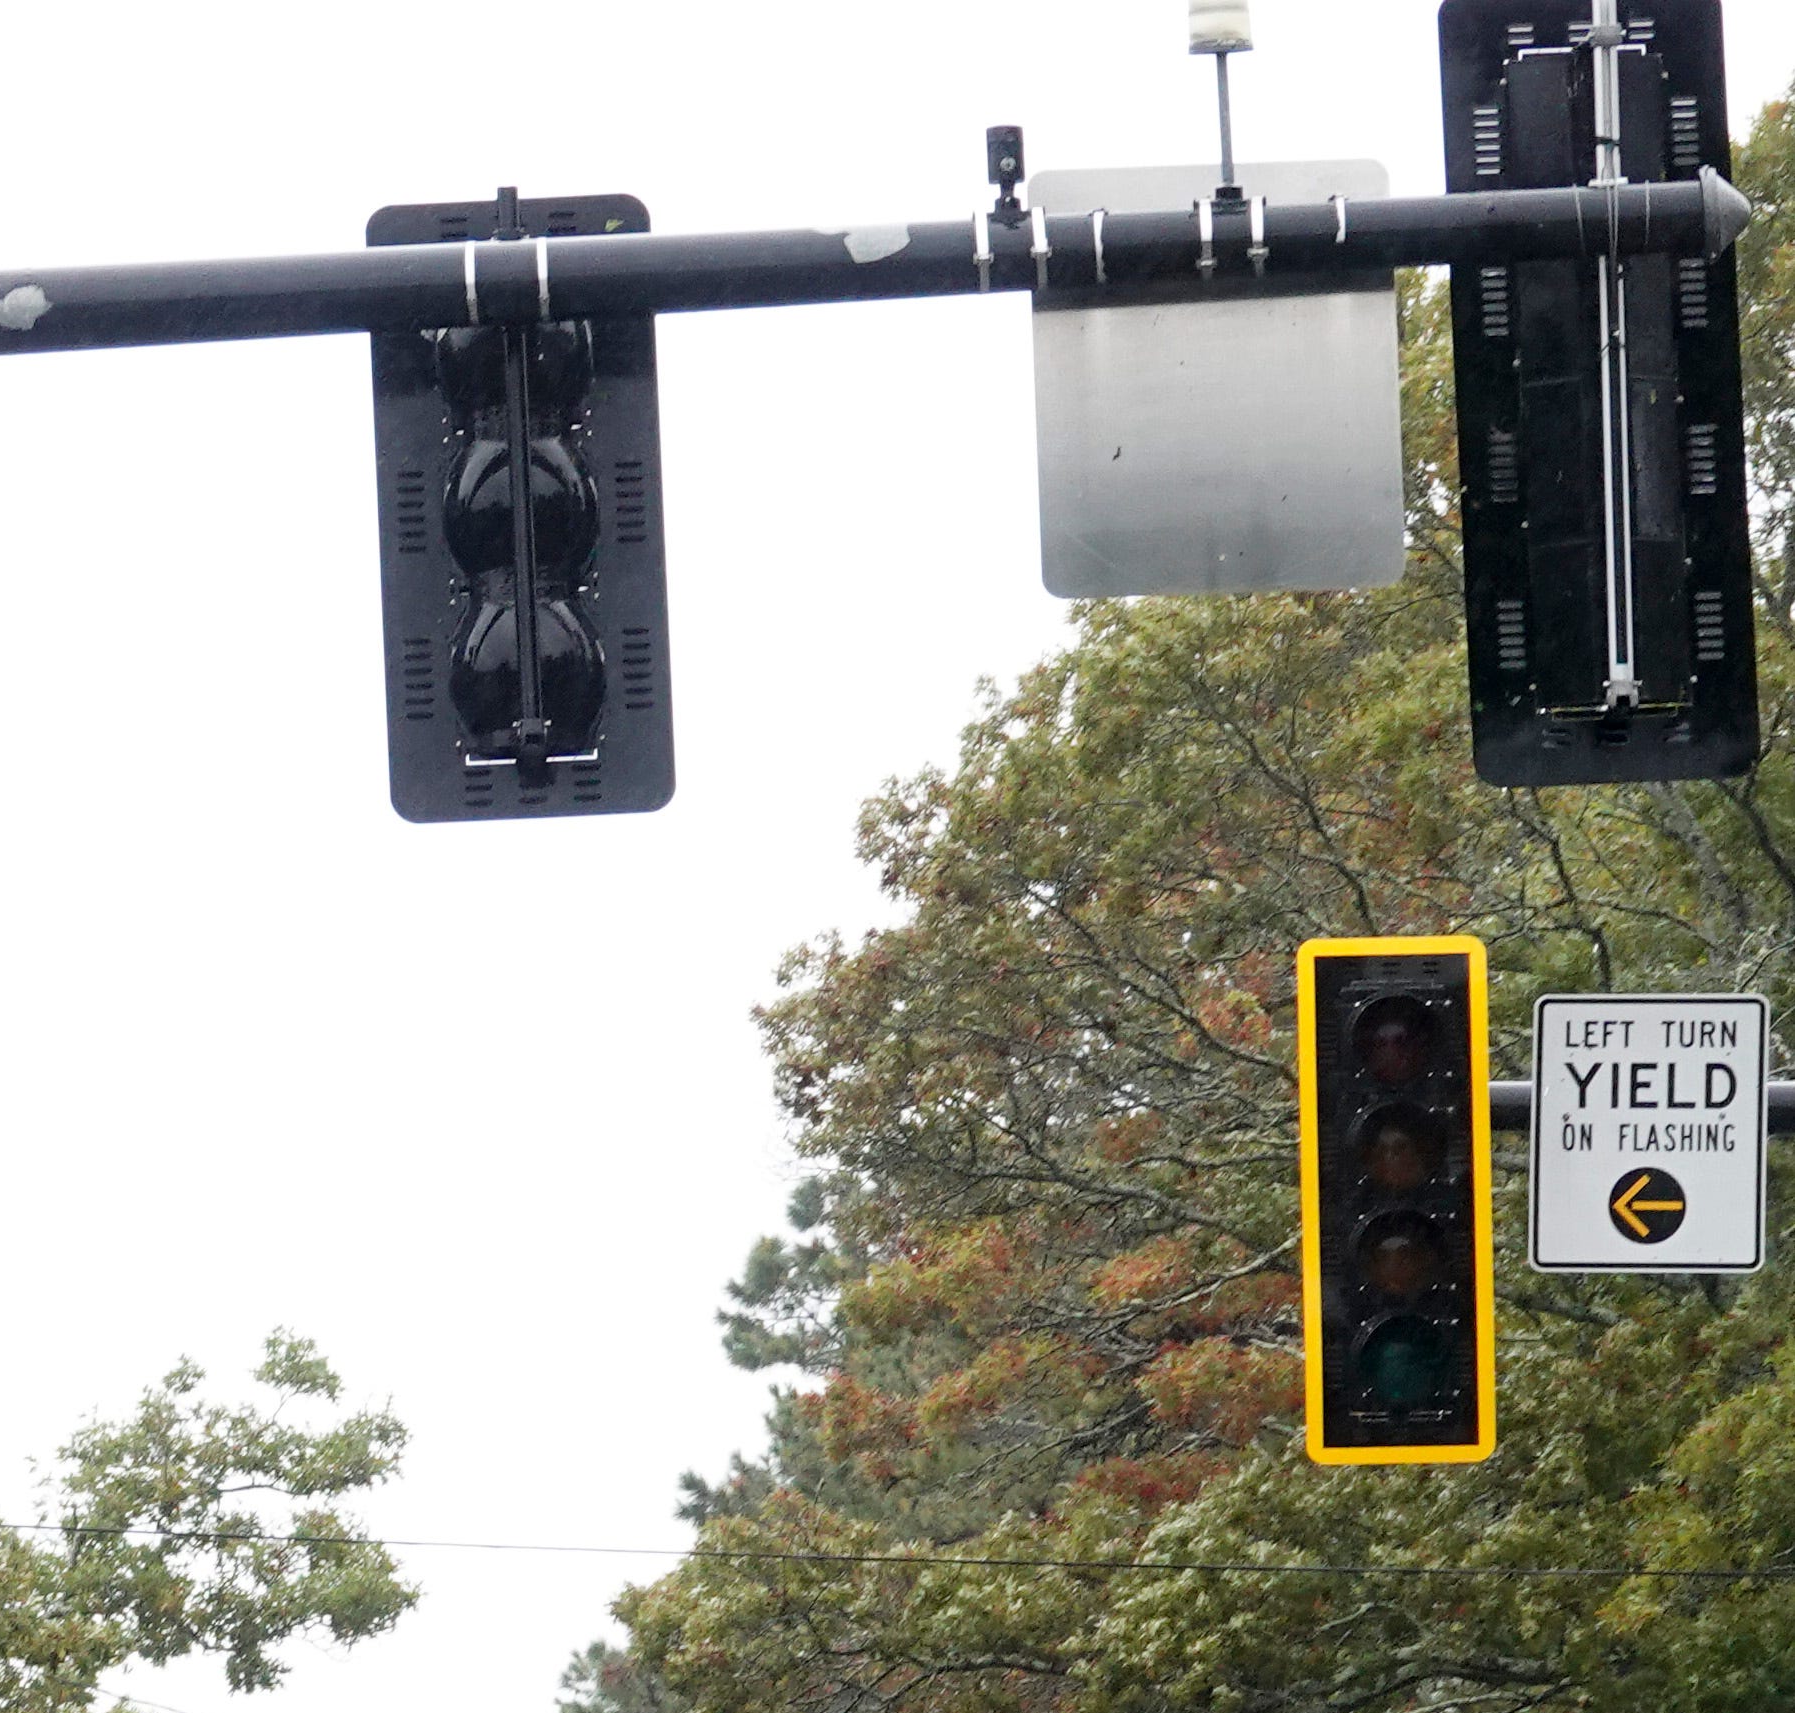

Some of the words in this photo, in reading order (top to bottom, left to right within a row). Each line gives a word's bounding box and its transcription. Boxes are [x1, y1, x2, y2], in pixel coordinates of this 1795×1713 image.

[1565, 1020, 1635, 1048] LEFT
[1661, 1020, 1738, 1048] TURN
[1564, 1062, 1738, 1109] YIELD
[1562, 1123, 1593, 1151] ON
[1618, 1123, 1736, 1151] FLASHING
